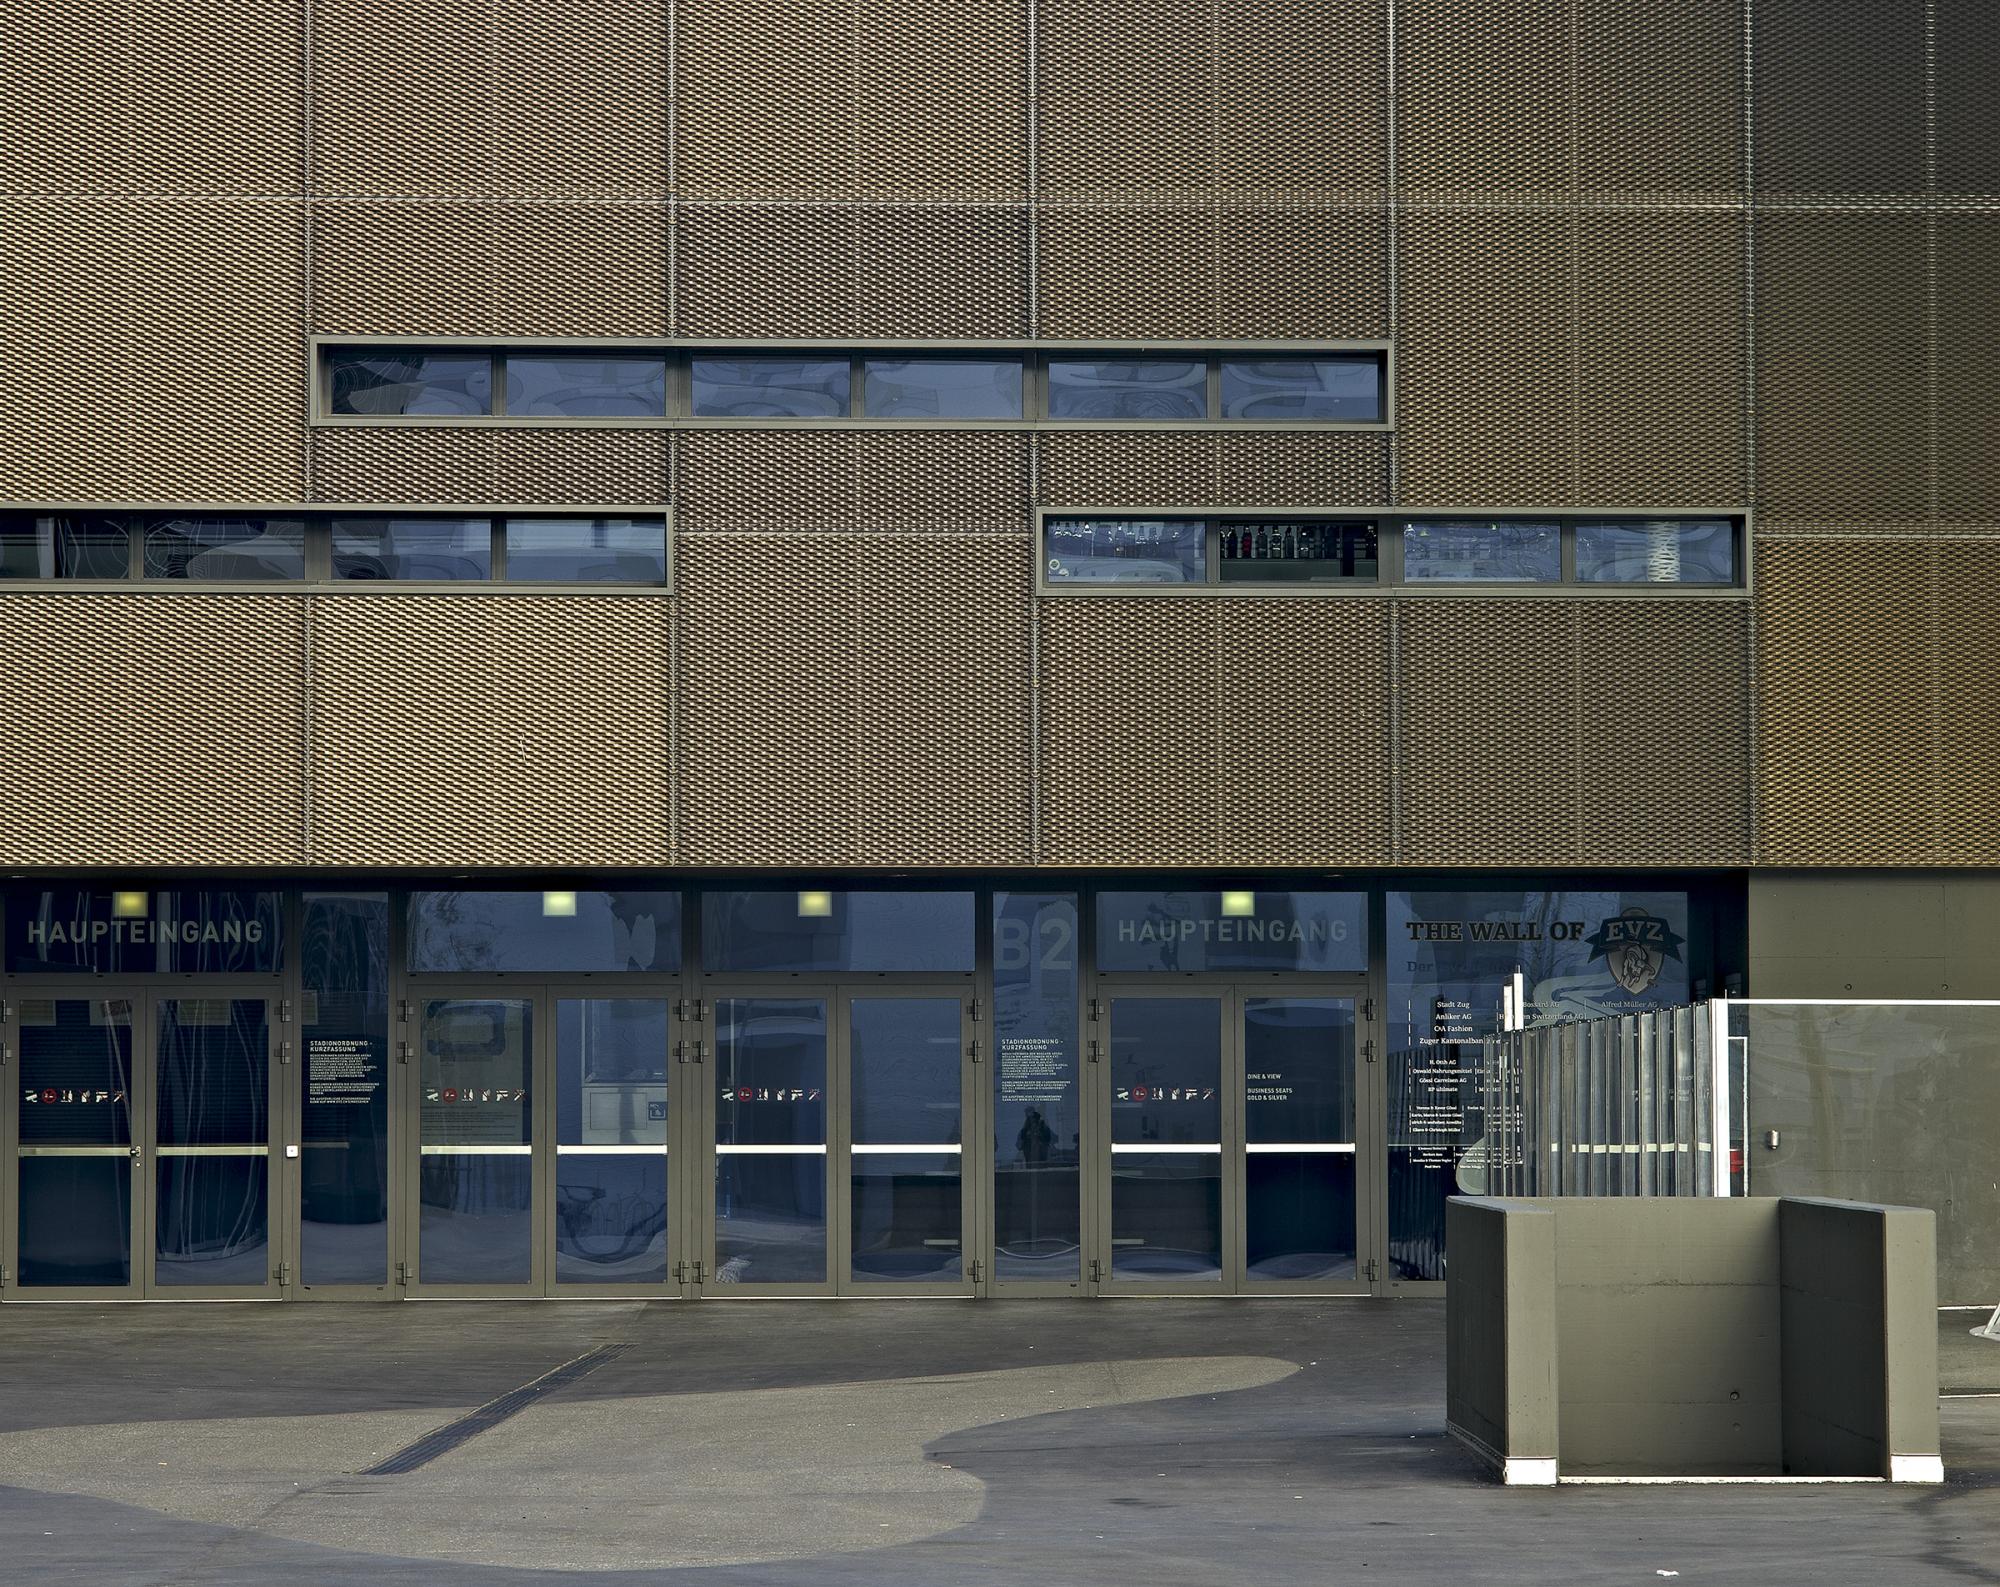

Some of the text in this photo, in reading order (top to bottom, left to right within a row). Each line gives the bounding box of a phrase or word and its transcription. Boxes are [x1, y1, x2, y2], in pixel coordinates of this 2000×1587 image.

[27, 920, 263, 944] HAUPTEINGANG
[1118, 919, 1347, 943] HAUPTEINGANG
[1406, 920, 1585, 942] THE WALL OF
[1606, 919, 1664, 942] EVZ
[993, 918, 1073, 971] B2
[1407, 961, 1433, 973] Der
[1457, 1001, 1470, 1009] Zug
[1533, 1012, 1571, 1020] Switzerland
[1420, 1037, 1485, 1046] Zuger Kantonalban
